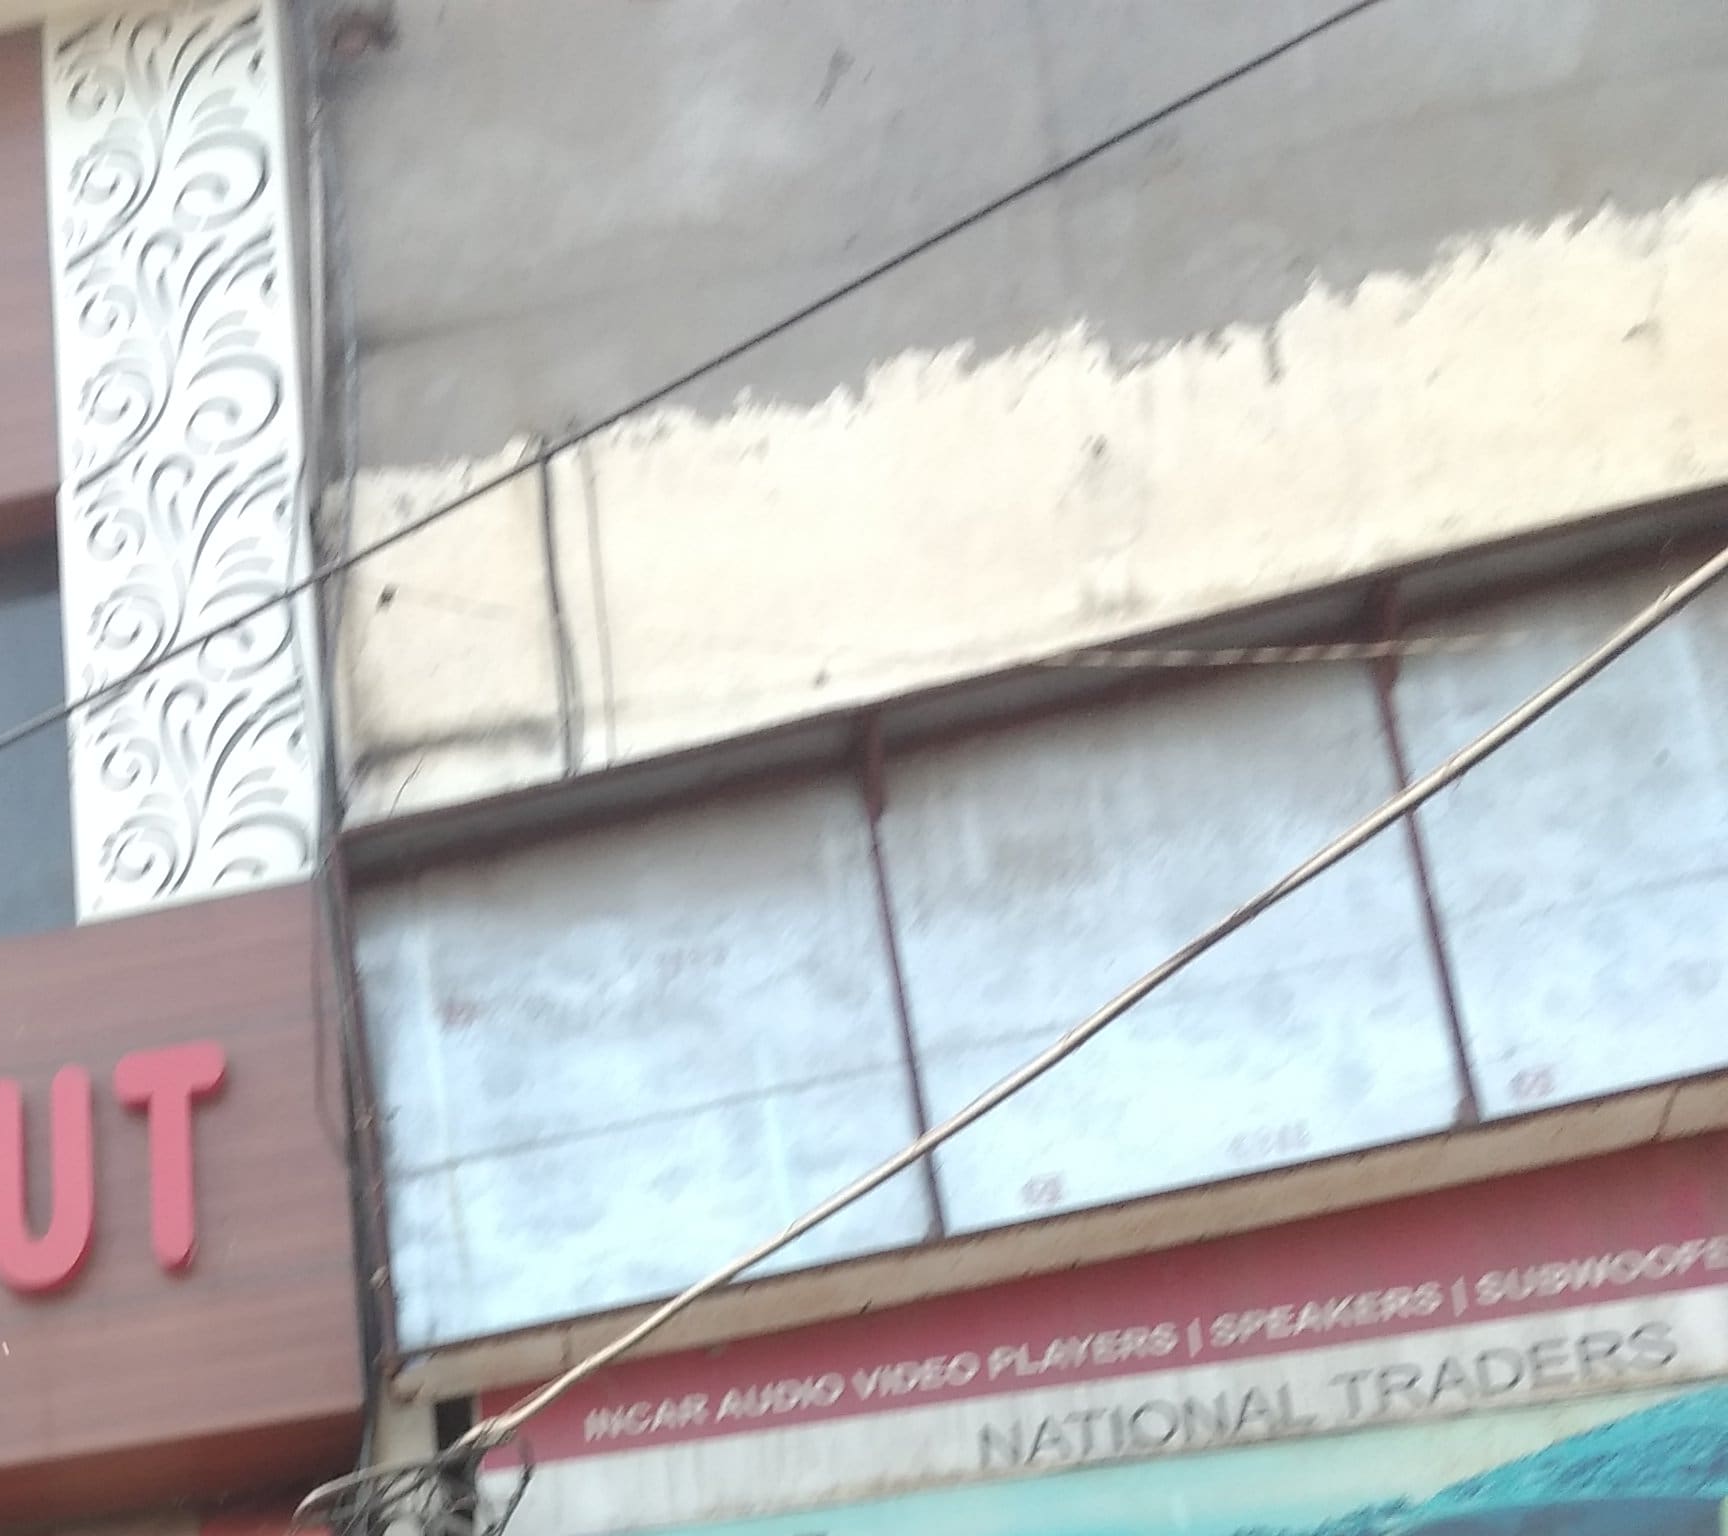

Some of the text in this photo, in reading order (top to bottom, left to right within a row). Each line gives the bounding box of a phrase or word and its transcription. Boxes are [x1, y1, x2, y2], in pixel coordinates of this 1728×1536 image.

[584, 1392, 709, 1442] INCAR
[716, 1372, 847, 1424] AUDIO
[851, 1351, 981, 1399] VIDEO
[988, 1318, 1178, 1380] PLAYERS
[1209, 1280, 1442, 1348] SPEAKERS
[979, 1320, 1678, 1469] NATIONAL TRADERS
